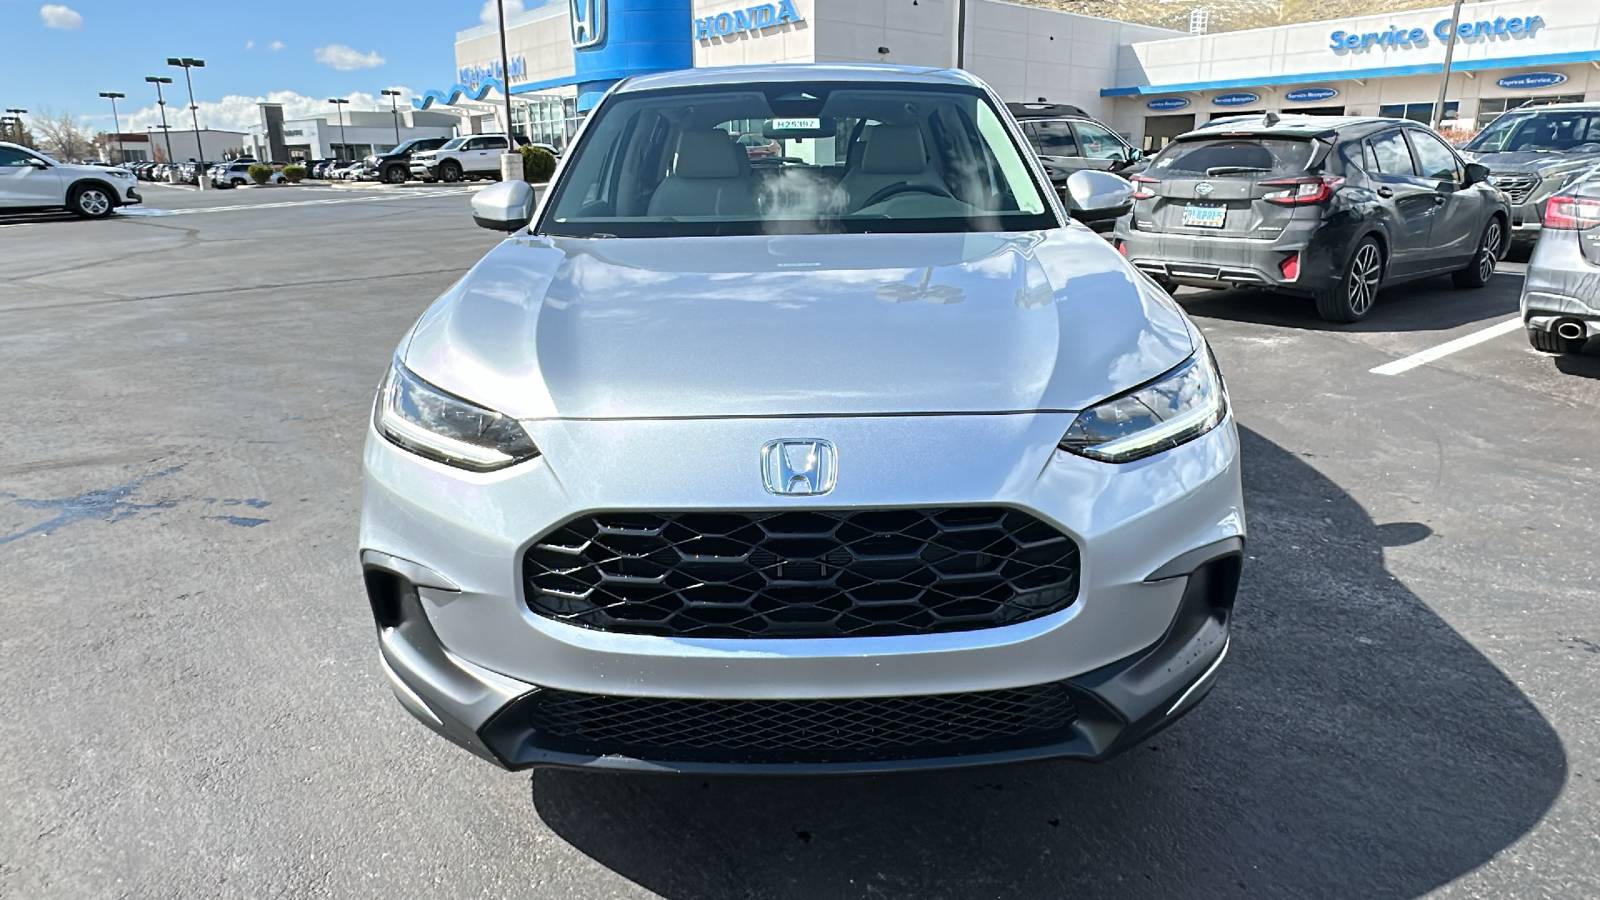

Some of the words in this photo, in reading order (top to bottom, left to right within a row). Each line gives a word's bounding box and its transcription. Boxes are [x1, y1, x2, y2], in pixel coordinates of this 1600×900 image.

[694, 0, 800, 40] HONDA
[1329, 24, 1425, 49] Service
[1432, 14, 1540, 40] Center
[1499, 79, 1525, 87] Express
[1526, 77, 1552, 85] Service
[777, 120, 815, 129] H25397
